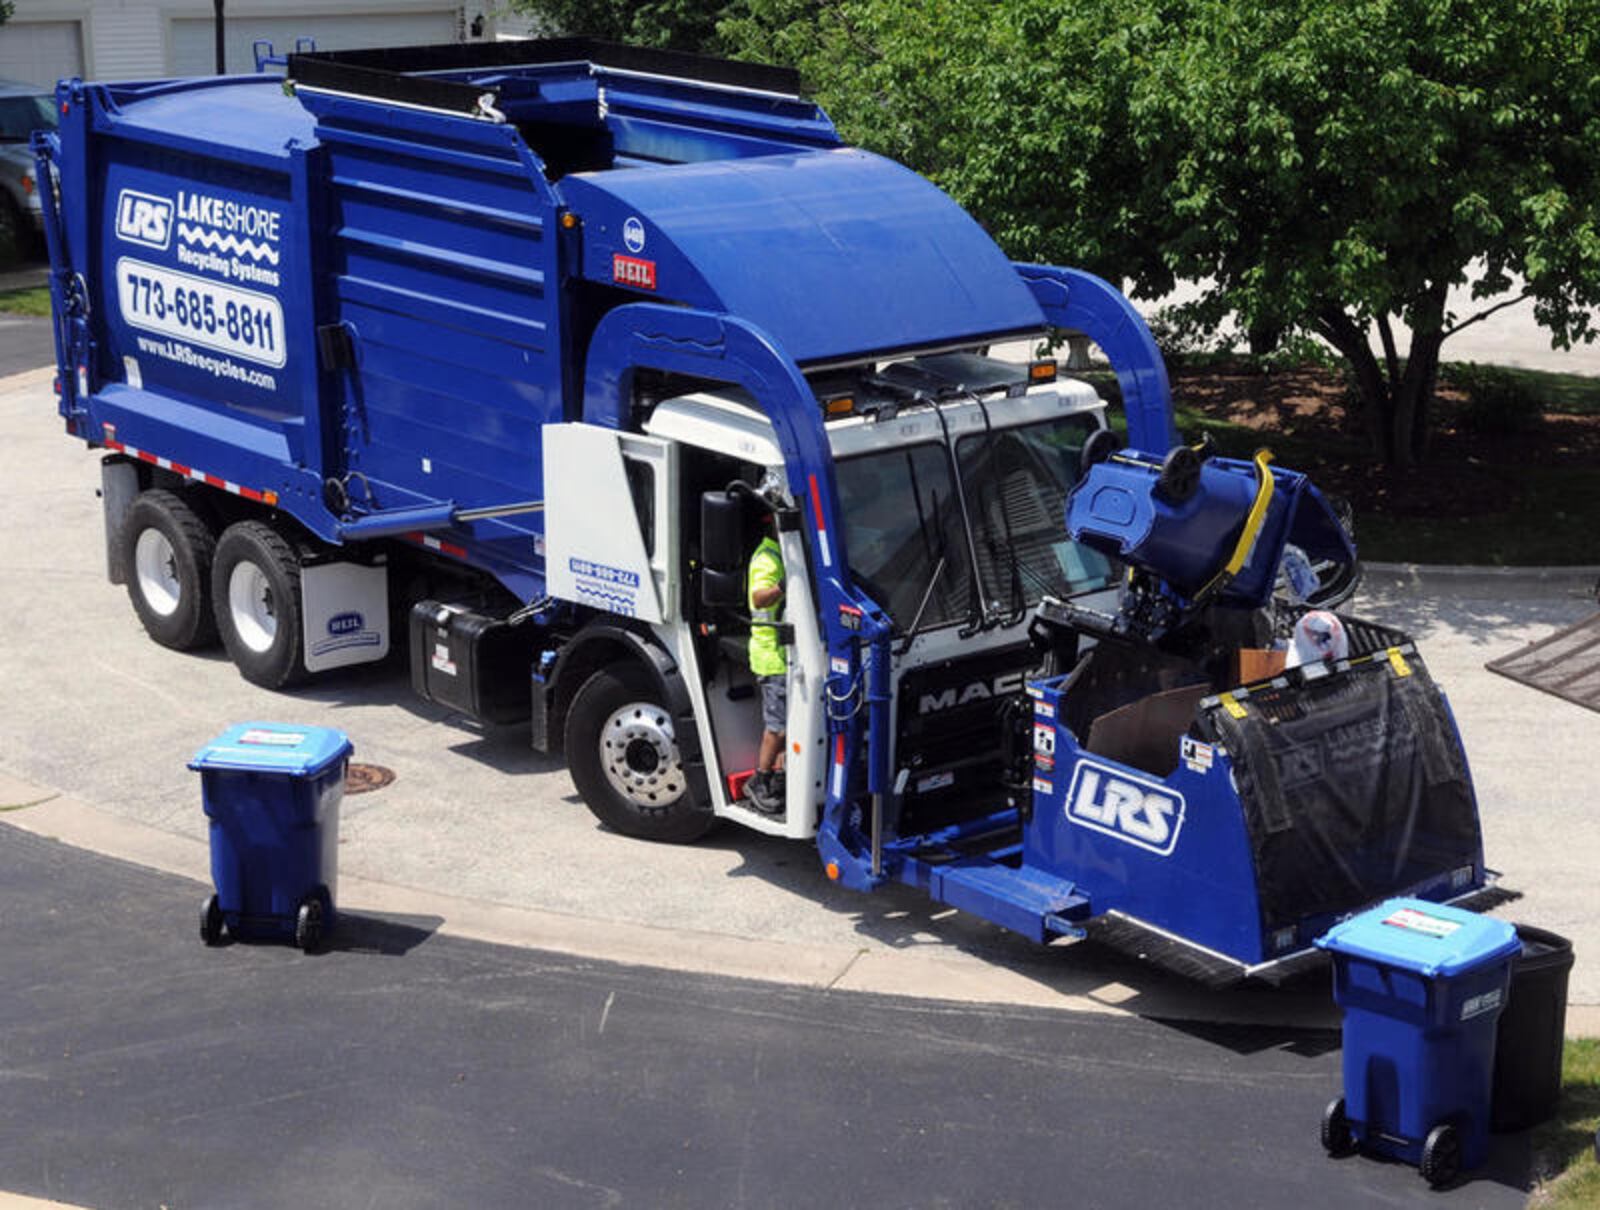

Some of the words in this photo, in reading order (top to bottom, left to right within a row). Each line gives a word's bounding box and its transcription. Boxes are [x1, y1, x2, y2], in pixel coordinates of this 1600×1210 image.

[119, 197, 169, 243] LRS
[177, 190, 281, 242] LAKESHORE
[177, 243, 230, 277] Recycling
[231, 257, 280, 287] Systems
[614, 260, 653, 285] HEIL
[127, 273, 275, 351] 773-685-8811
[137, 336, 277, 391] www.LRSrecycles.com
[1072, 769, 1175, 844] LRS
